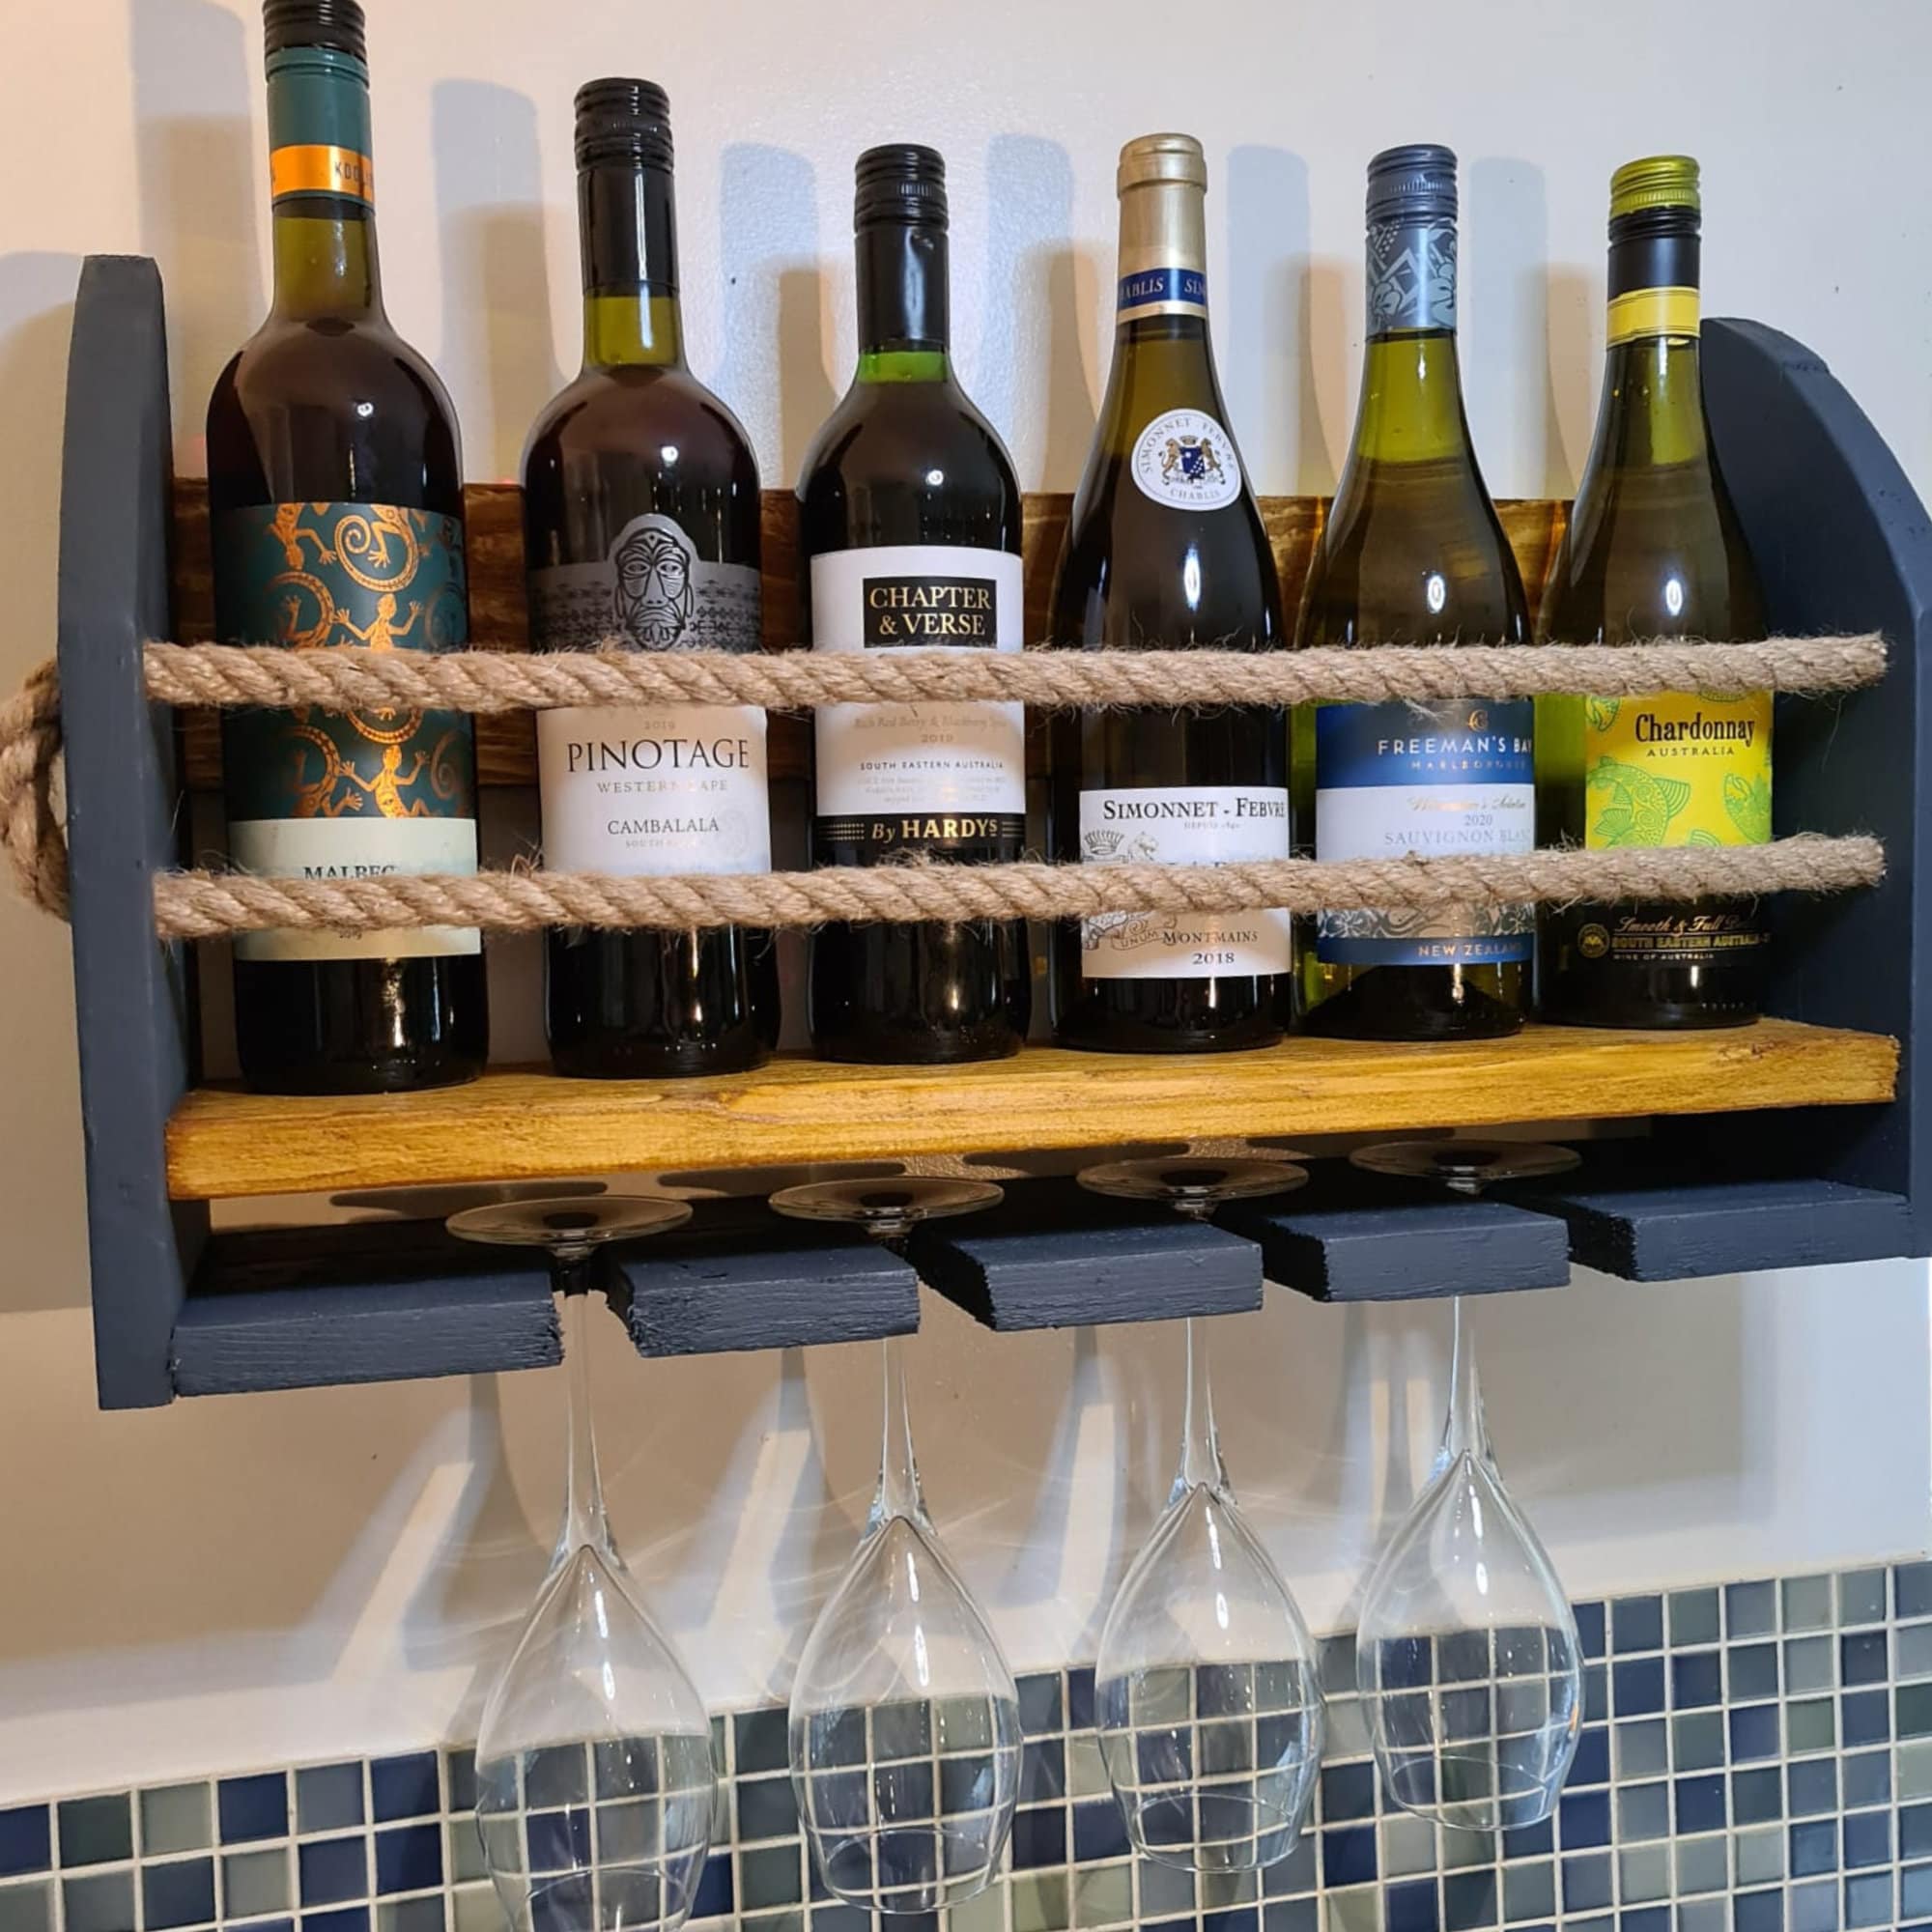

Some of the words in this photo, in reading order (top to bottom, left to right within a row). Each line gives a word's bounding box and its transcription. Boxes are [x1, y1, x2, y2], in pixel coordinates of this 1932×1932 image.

[1140, 416, 1190, 473] SIMONNET
[1169, 487, 1221, 500] CHABLIS
[869, 585, 992, 610] CHAPTER
[878, 614, 897, 636] &
[902, 612, 986, 637] VERSE
[1635, 711, 1755, 748] Chardonnay
[1378, 735, 1507, 755] FREEMAN'S
[1513, 737, 1533, 753] BAY
[1646, 746, 1735, 758] AUSTRALIA
[566, 738, 751, 773] PINOTAGE
[860, 761, 896, 771] SOUTH
[901, 761, 951, 770] EASTERN
[955, 759, 1004, 770] AUSTRALIA
[596, 780, 680, 794] WESTERN
[1103, 800, 1218, 820] SIMONNET
[607, 817, 721, 836] CAMBALALA
[1464, 814, 1493, 827] 2020
[871, 823, 895, 843] By
[1384, 828, 1494, 846] SAUVIGNON
[1614, 916, 1673, 933] Smooth
[1673, 919, 1687, 937] &
[1688, 915, 1725, 932] Full
[1122, 930, 1158, 948] UNUM
[1162, 929, 1259, 946] MONTMAINS
[1611, 936, 1654, 949] SOUTH
[1656, 935, 1711, 949] EASTERN
[1192, 952, 1236, 965] 2018
[1418, 945, 1457, 957] NEW
